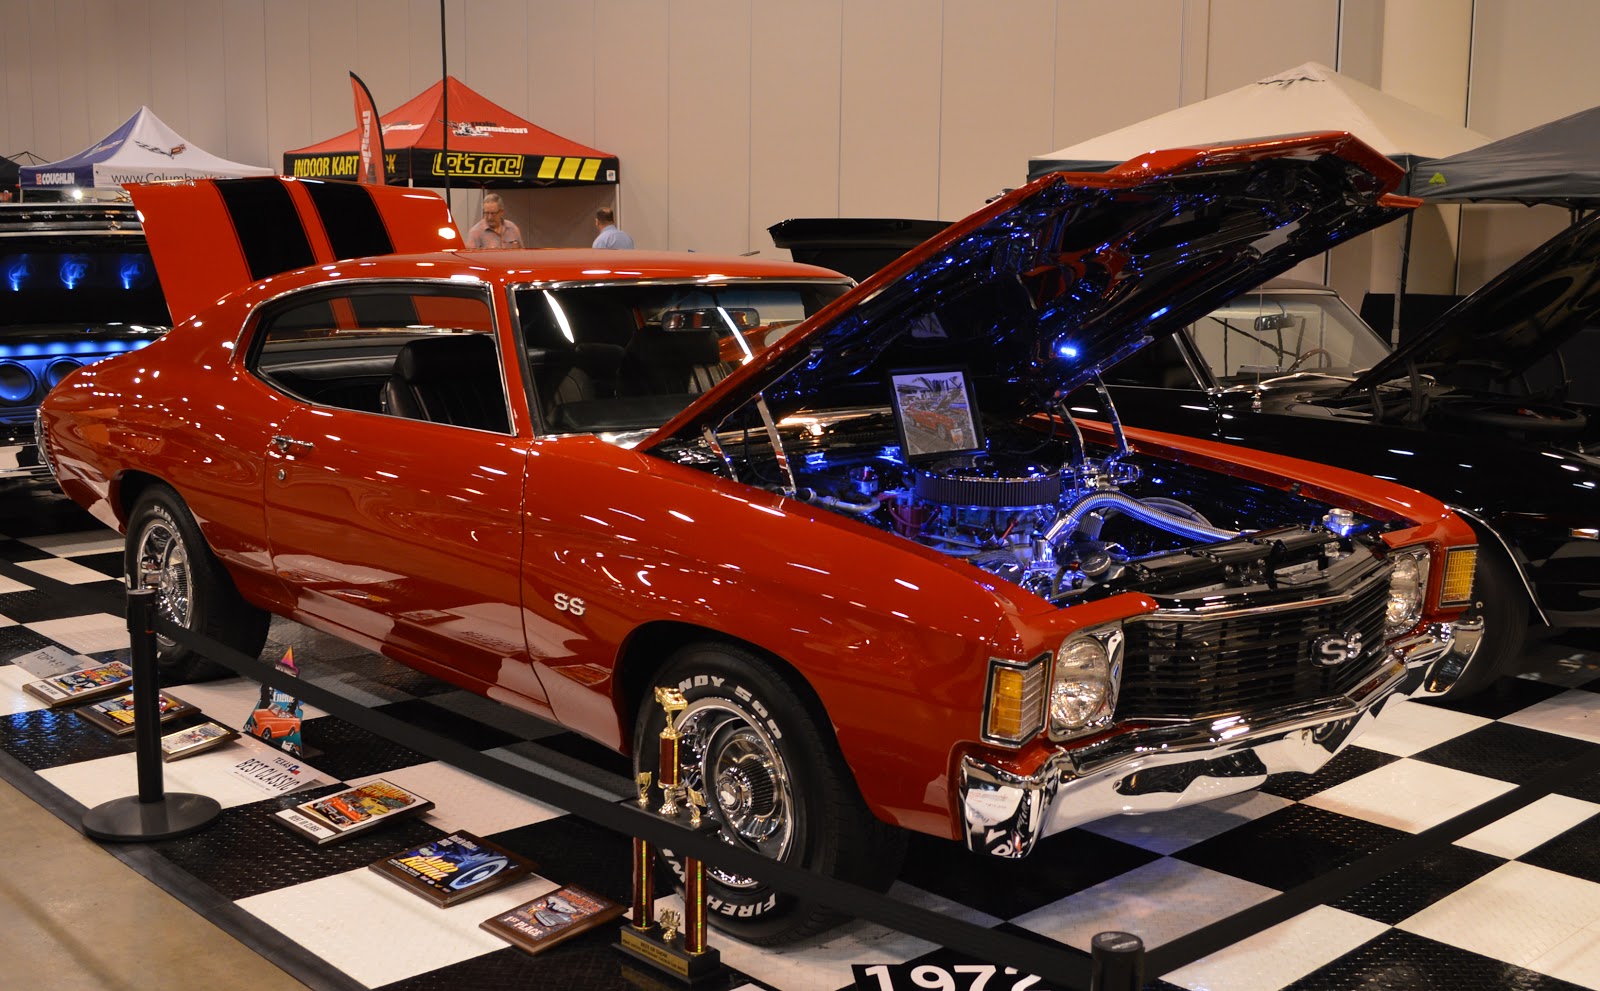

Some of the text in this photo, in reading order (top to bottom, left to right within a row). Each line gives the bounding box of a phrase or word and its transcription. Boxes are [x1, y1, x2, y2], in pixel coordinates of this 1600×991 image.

[475, 125, 528, 134] position
[293, 155, 360, 177] INDOOR KART
[436, 152, 522, 175] Let's race!
[42, 172, 75, 185] COUGHLIN
[553, 592, 586, 616] SS
[678, 674, 783, 740] NDY 500
[273, 757, 293, 768] TEXAS
[235, 758, 269, 774] BEST
[255, 768, 301, 791] CLASSIC
[514, 921, 544, 937] PLACE
